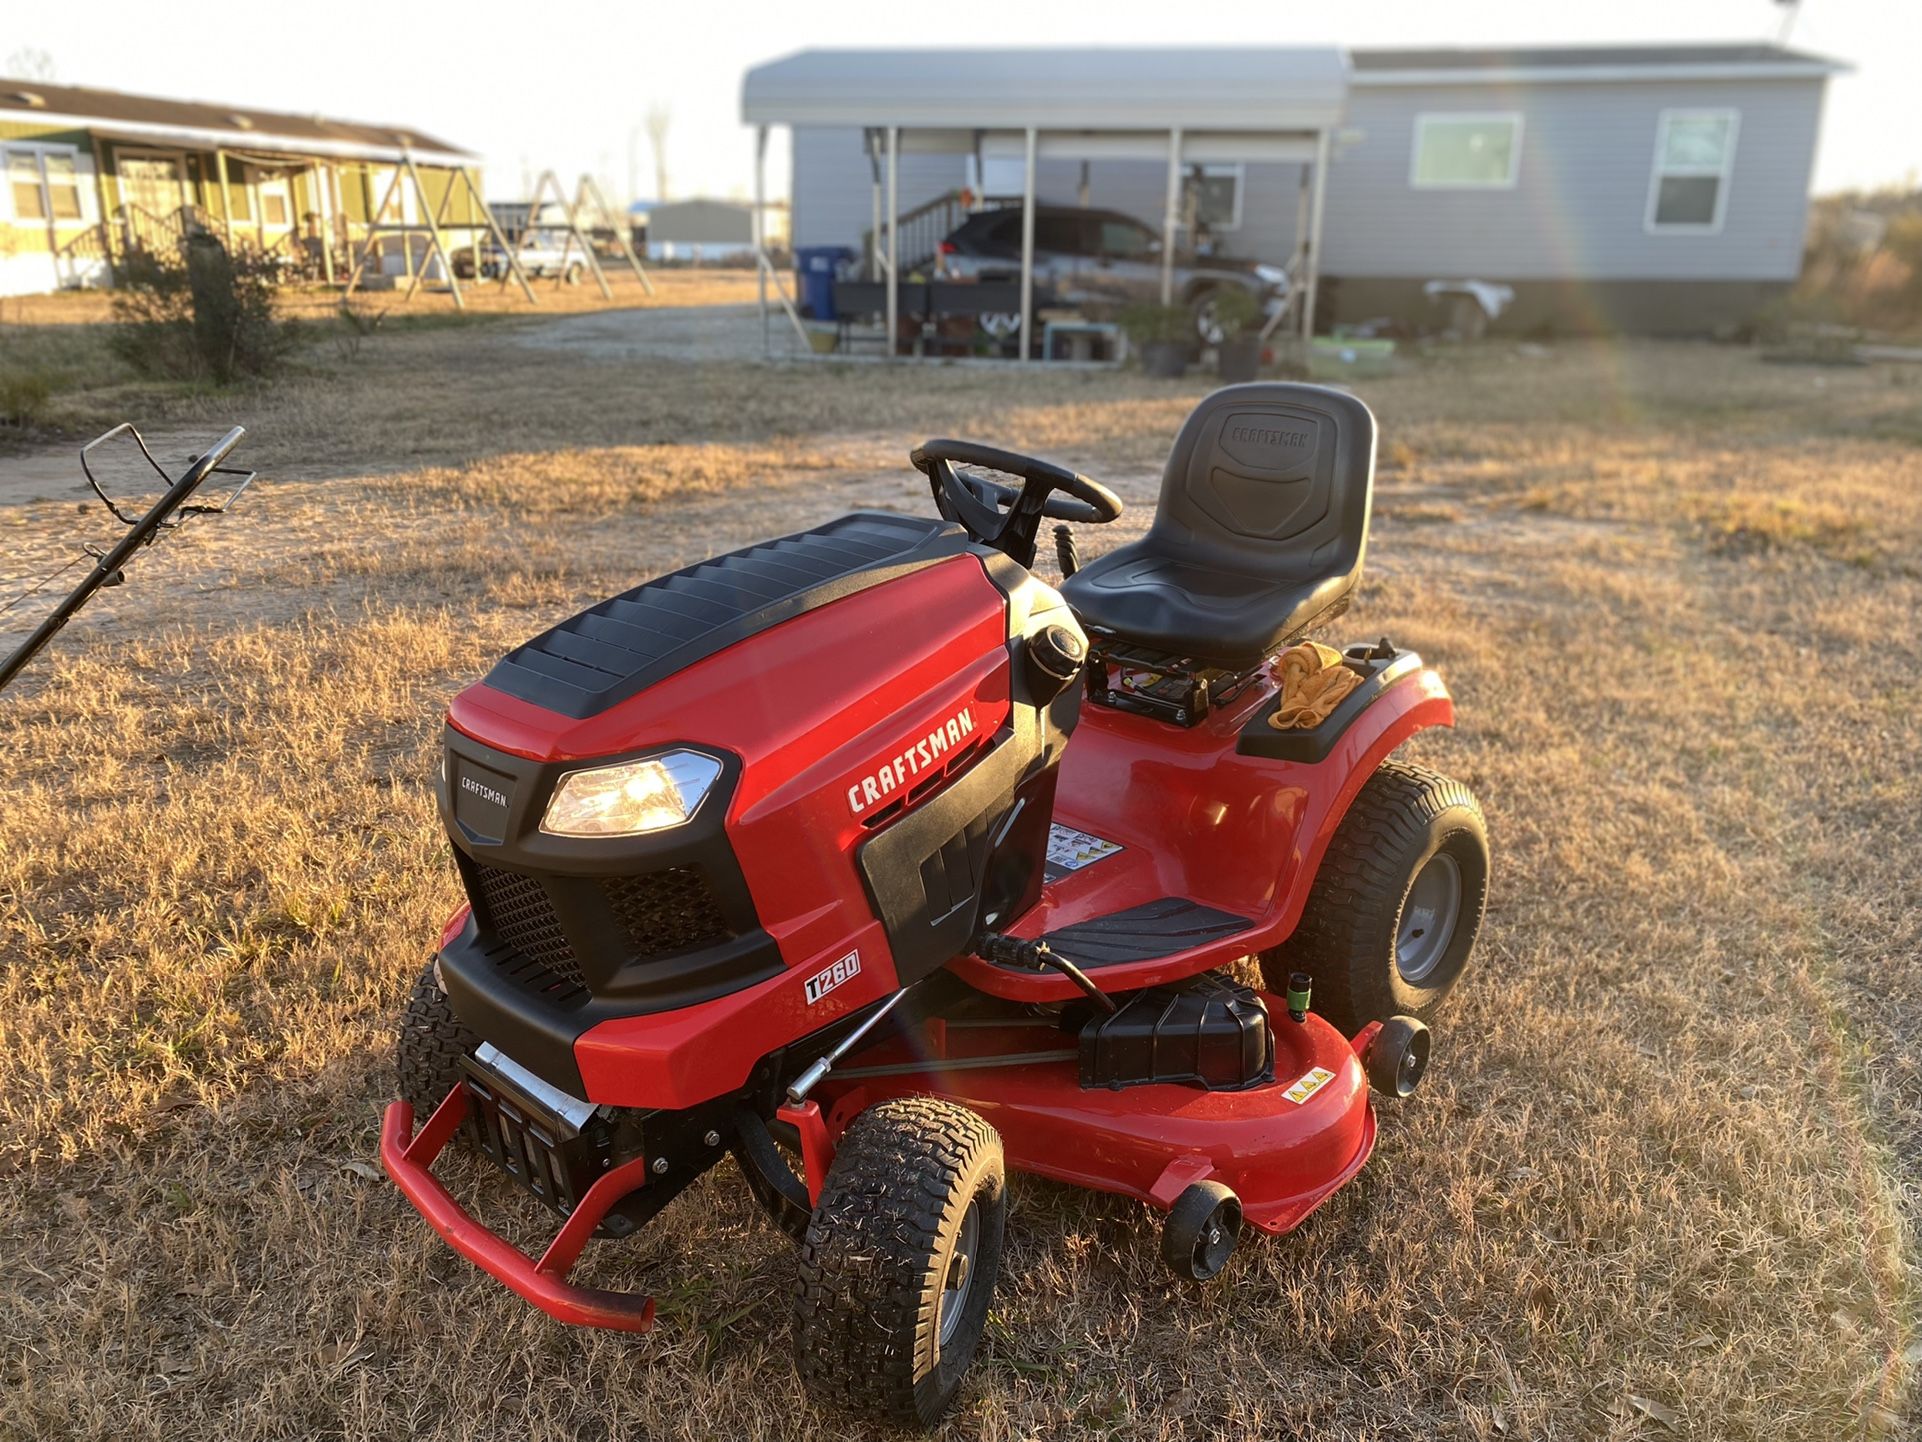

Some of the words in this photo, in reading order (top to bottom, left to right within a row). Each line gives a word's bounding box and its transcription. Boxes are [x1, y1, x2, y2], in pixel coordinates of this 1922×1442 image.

[1231, 427, 1308, 447] CRAFTSMAN
[848, 707, 974, 813] CRAFTSMAN
[461, 776, 507, 807] CRAFTSMAN
[806, 953, 858, 999] T260
